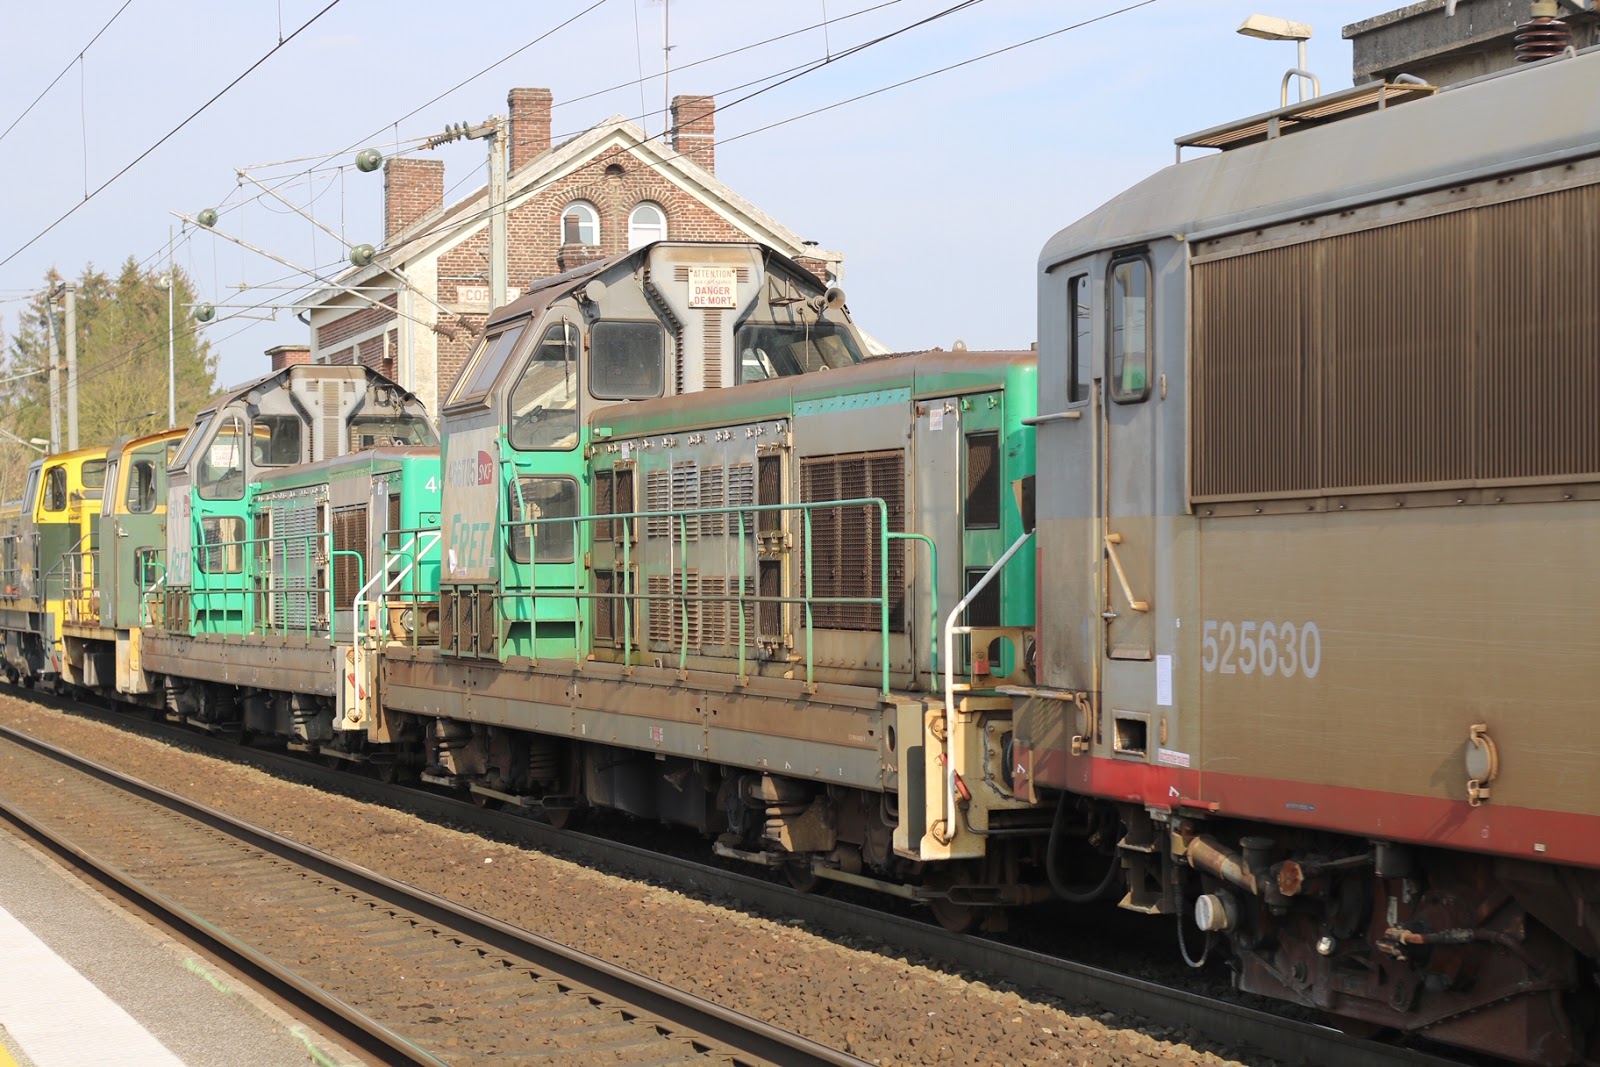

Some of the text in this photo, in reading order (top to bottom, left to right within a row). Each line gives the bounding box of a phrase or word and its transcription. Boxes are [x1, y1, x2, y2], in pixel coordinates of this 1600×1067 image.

[693, 269, 732, 278] ATTENTION
[466, 289, 511, 302] CORE
[695, 286, 730, 295] DANGER
[694, 296, 732, 305] DE MORT
[449, 514, 490, 568] FRET
[1202, 620, 1320, 678] 525630
